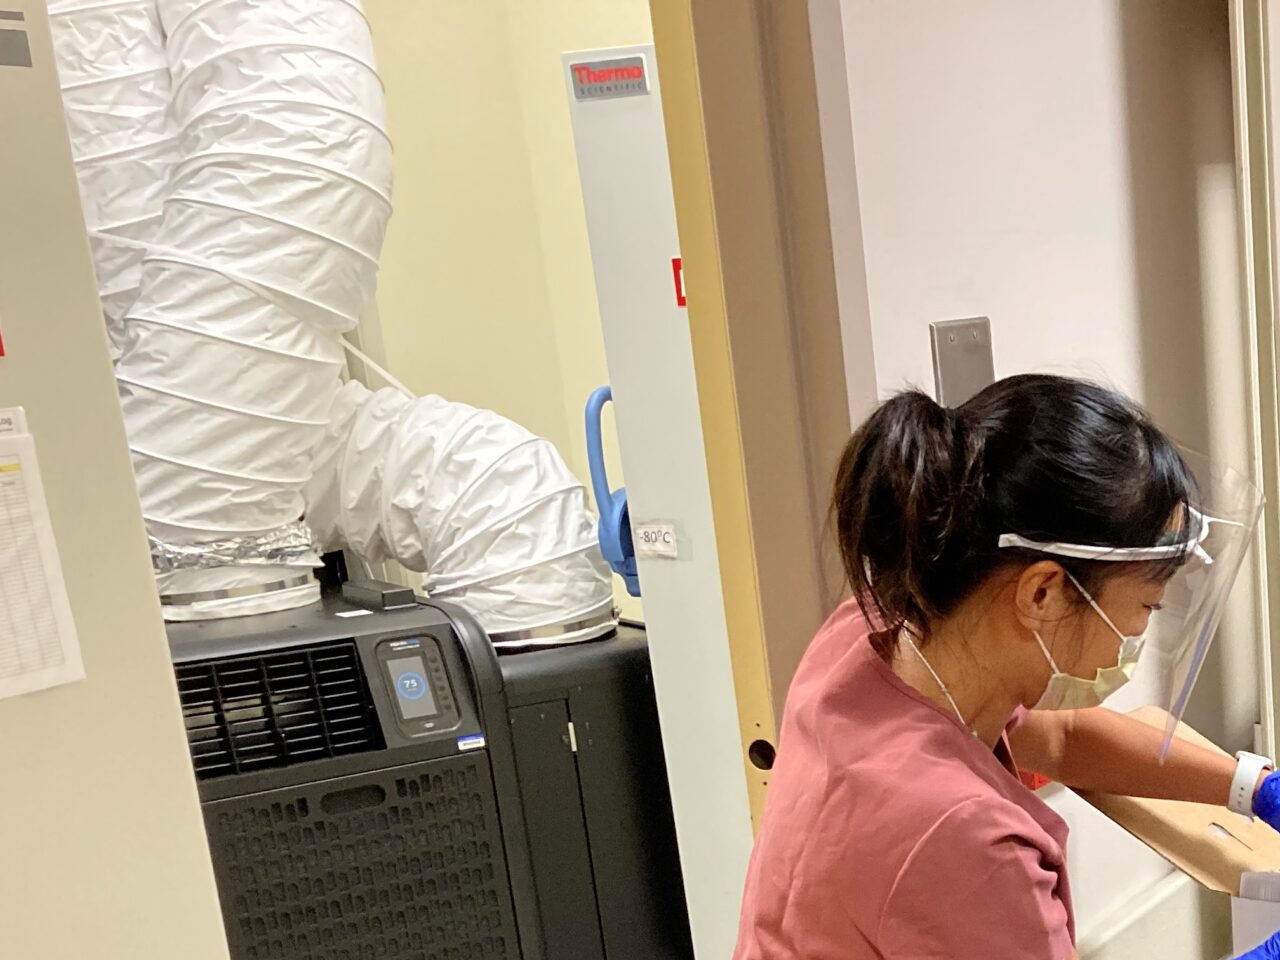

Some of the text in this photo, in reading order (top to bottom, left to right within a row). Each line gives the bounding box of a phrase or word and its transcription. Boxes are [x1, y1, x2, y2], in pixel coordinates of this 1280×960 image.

[573, 65, 643, 84] Thermo
[580, 82, 643, 95] SCIENTIFIC
[403, 680, 418, 689] 75
